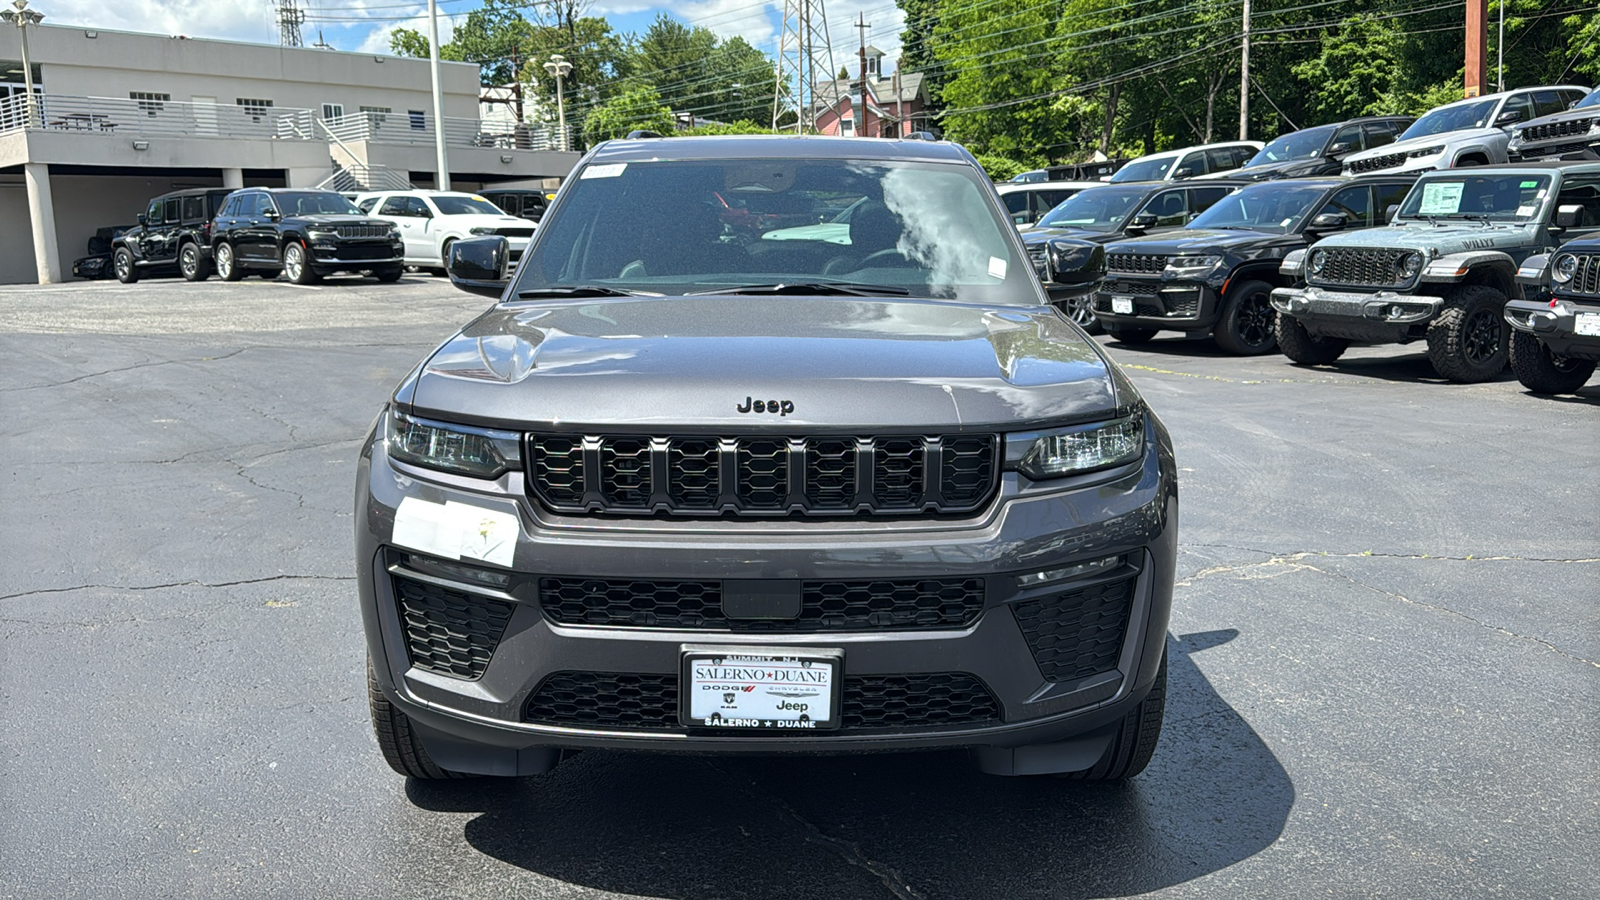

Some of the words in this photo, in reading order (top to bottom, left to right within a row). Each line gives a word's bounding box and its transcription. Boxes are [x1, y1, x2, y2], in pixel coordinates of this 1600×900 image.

[1462, 238, 1495, 250] WILLYS
[736, 396, 794, 416] Jeep
[696, 668, 765, 681] SALERNO
[774, 670, 828, 683] DUANE
[776, 700, 809, 713] Jeep
[704, 717, 760, 728] SALERNO
[777, 720, 816, 728] DUANE
